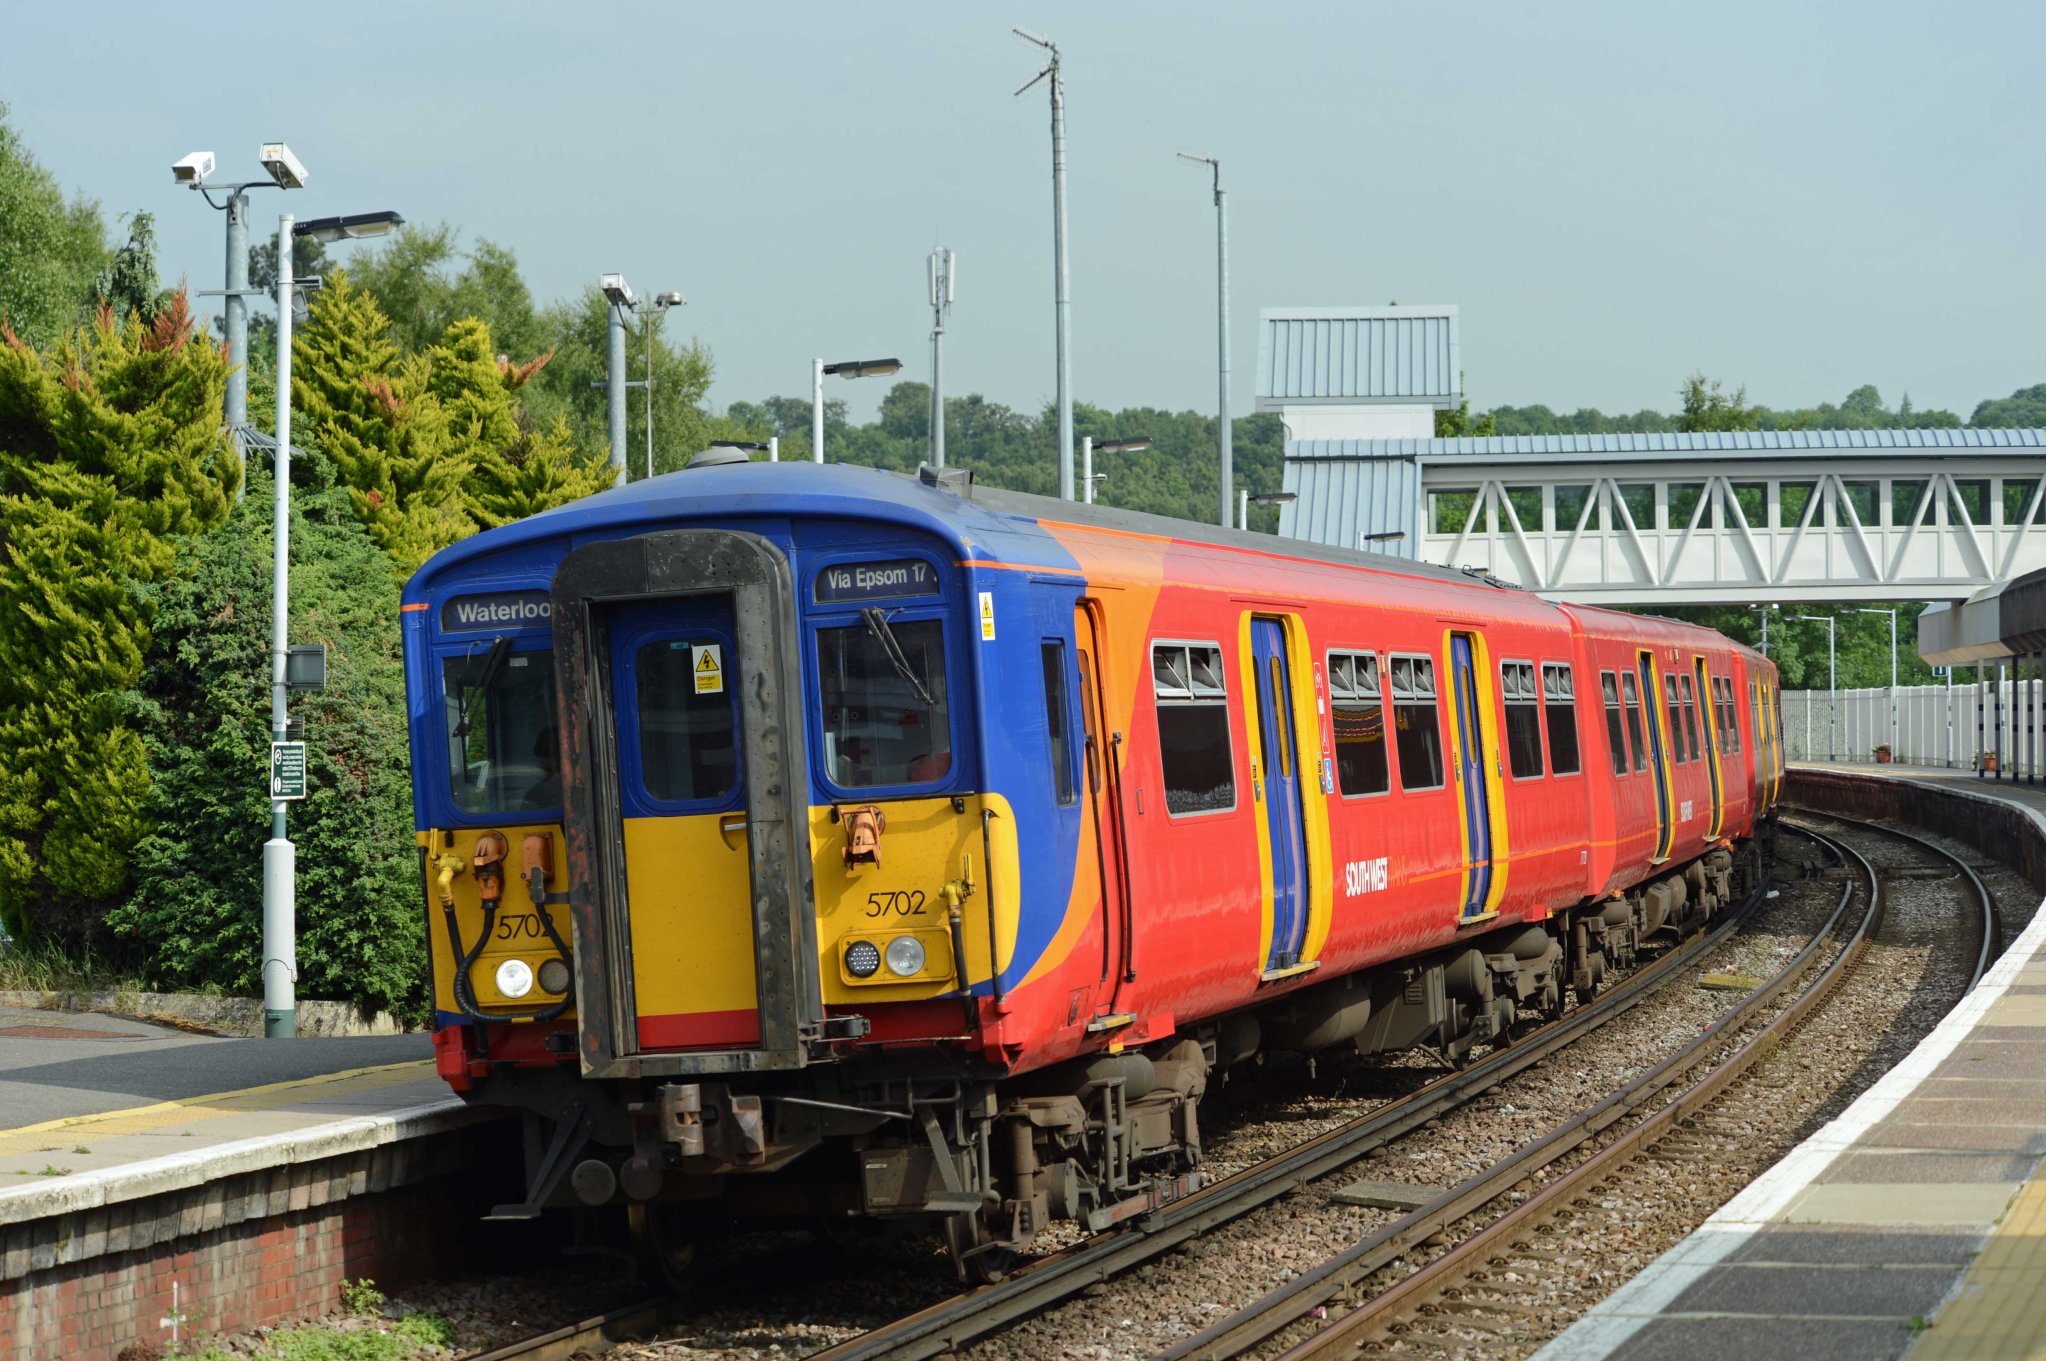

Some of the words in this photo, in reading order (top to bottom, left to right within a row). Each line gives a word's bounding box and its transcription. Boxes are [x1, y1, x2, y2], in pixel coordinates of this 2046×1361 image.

[828, 570, 851, 589] Via
[856, 567, 907, 590] Epsom
[912, 563, 927, 582] 17
[457, 600, 552, 623] Waterloo
[1346, 860, 1370, 898] SOUTH
[1369, 856, 1388, 892] WEST
[866, 890, 927, 917] 5702
